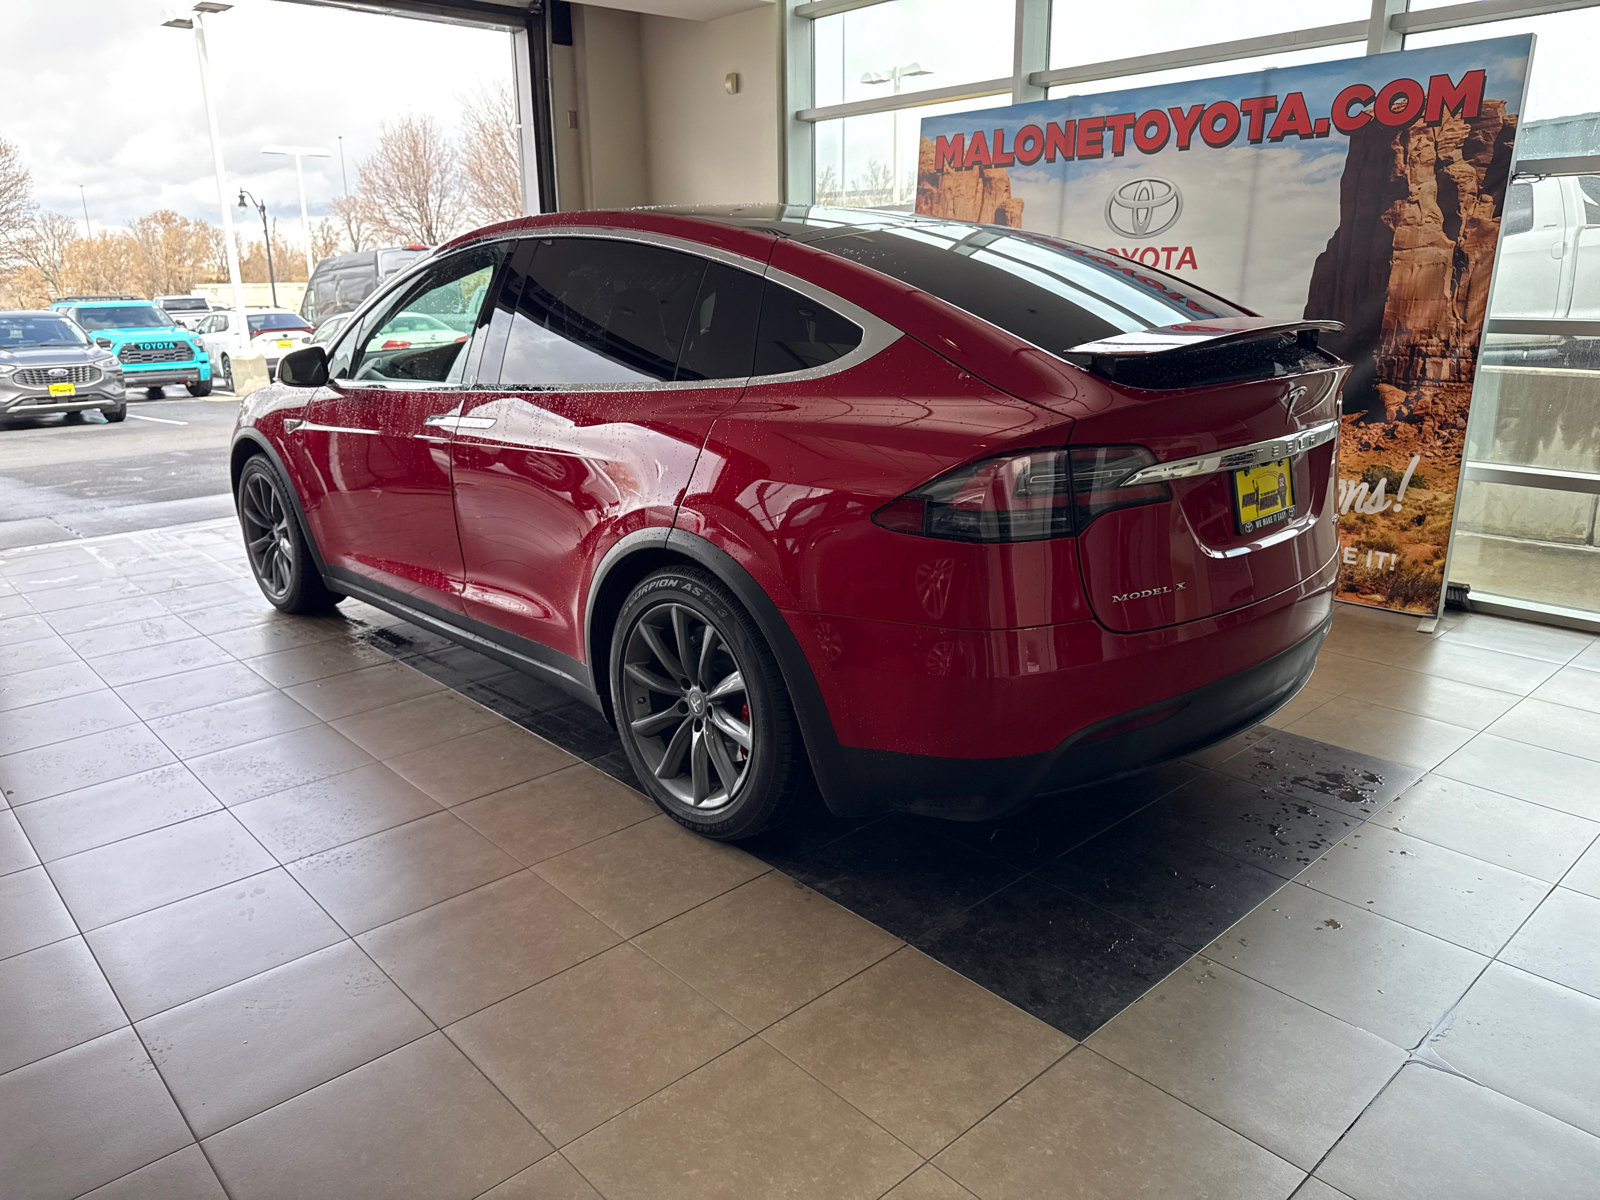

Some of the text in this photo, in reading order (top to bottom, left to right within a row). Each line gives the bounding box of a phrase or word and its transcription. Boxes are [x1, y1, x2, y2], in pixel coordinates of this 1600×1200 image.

[934, 69, 1486, 171] MALONETOYOTA.COM
[1106, 246, 1198, 270] YOTA
[138, 342, 175, 350] TOYOTA
[1257, 435, 1315, 460] TESLA
[1343, 546, 1397, 571] E IT!
[623, 578, 678, 616] SCORPION
[681, 583, 703, 597] AS
[1112, 582, 1186, 603] MODEL X
